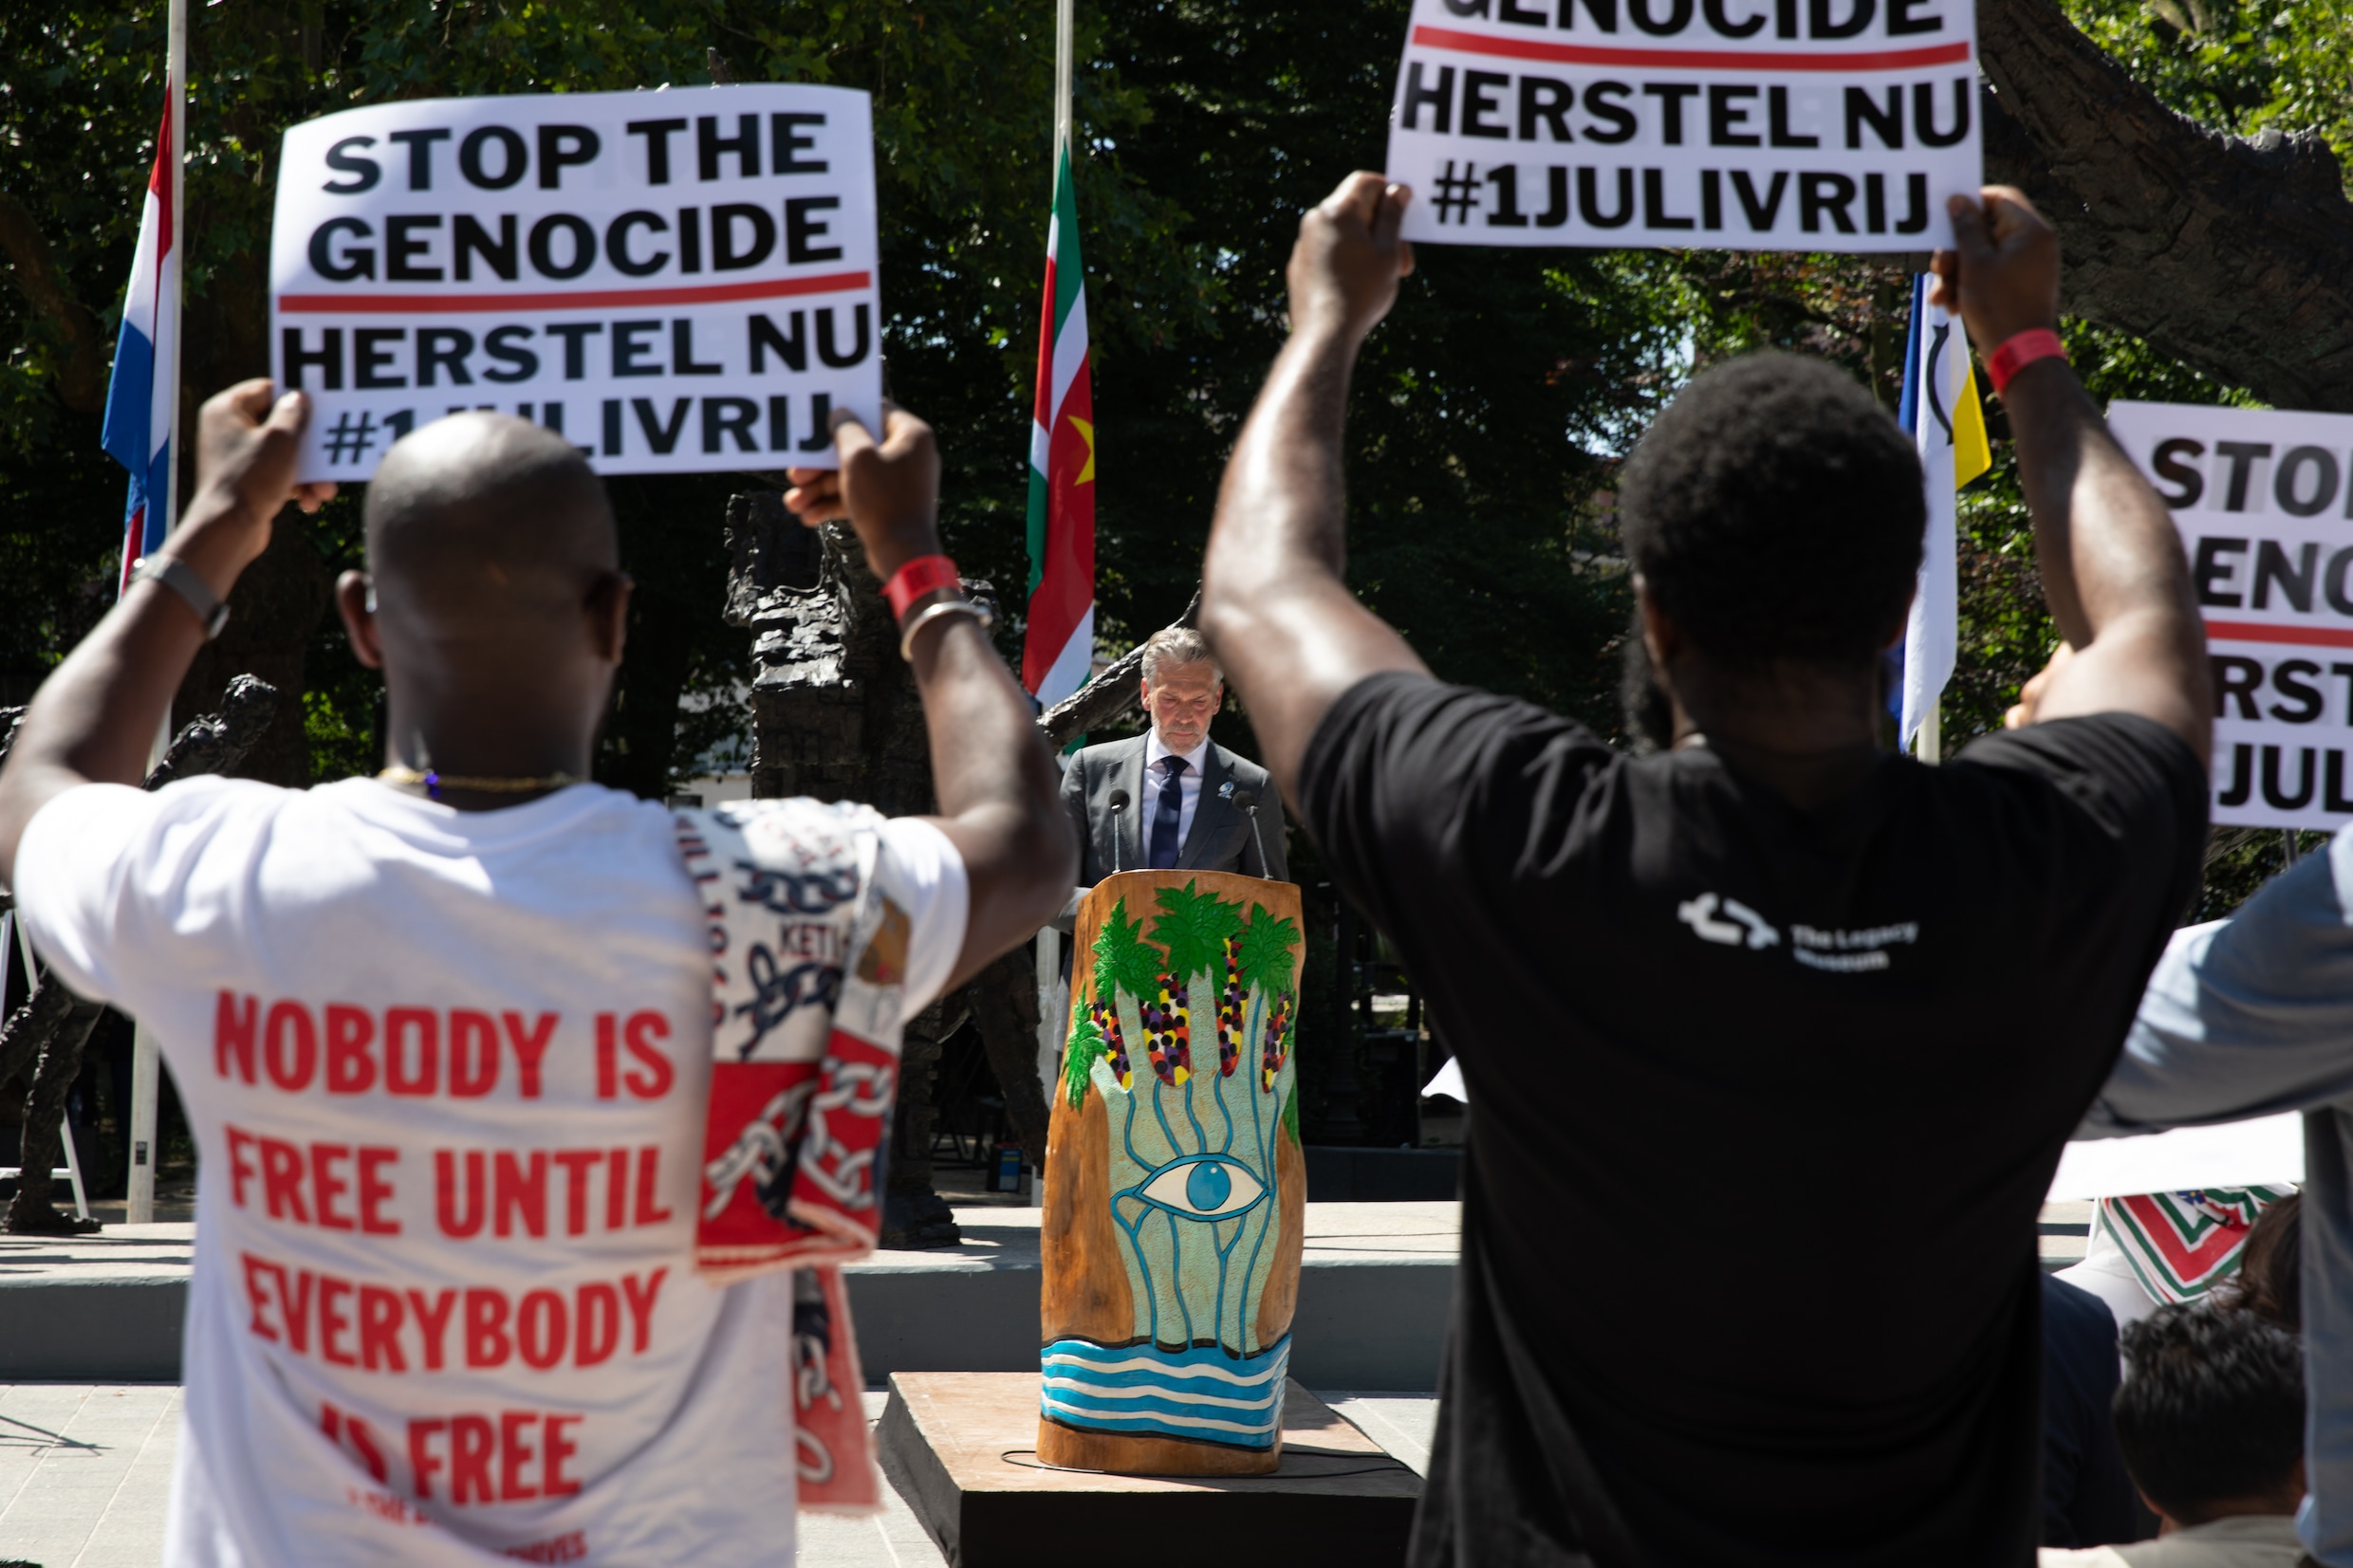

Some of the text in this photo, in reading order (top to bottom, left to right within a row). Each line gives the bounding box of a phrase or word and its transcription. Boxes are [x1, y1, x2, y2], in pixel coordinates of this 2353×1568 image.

[1401, 62, 1970, 149] HERSTEL NU
[322, 113, 828, 194] STOP THE
[308, 196, 843, 282] GENOCIDE
[1431, 160, 1929, 235] #1JULIVRIJ
[282, 303, 871, 390] HERSTEL NU
[2152, 437, 2353, 520] STO
[214, 989, 676, 1101] NOBODY IS
[224, 1123, 673, 1241] FREE UNTIL
[240, 1249, 669, 1374] EVERYBODY
[406, 1410, 584, 1506] FREE
